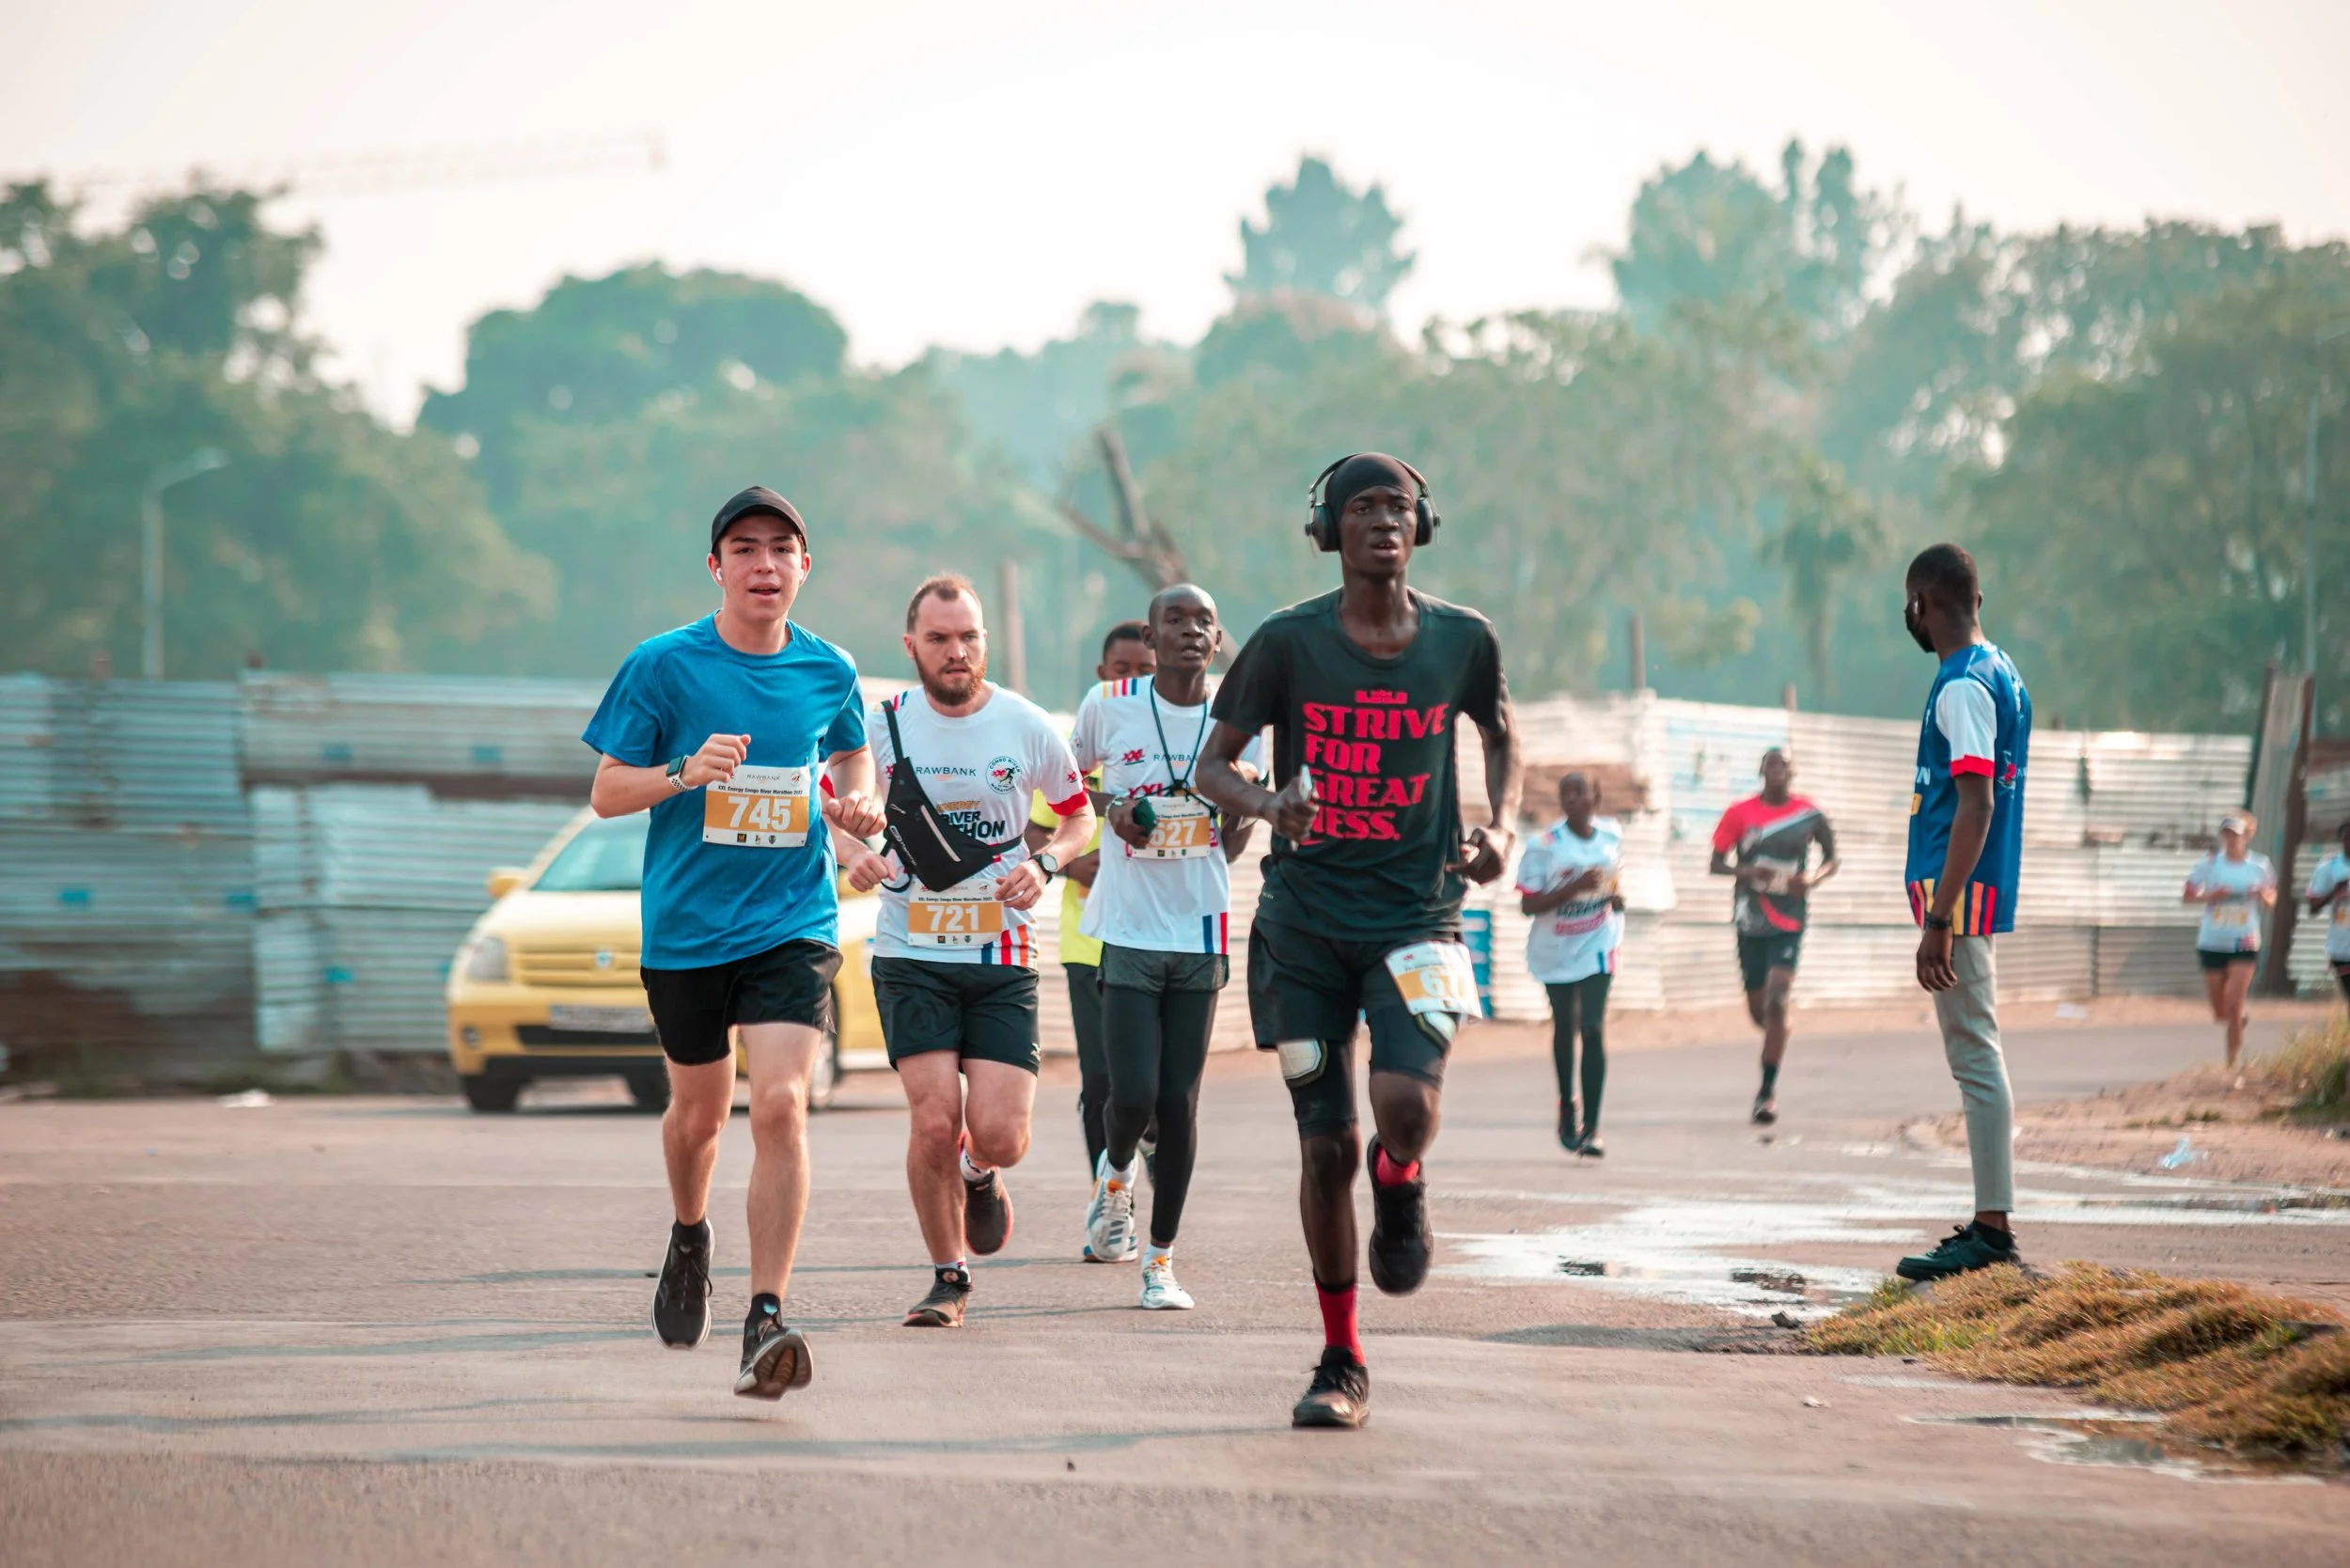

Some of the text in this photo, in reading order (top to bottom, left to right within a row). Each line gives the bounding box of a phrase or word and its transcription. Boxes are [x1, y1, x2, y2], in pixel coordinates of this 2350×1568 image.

[1302, 701, 1449, 741] STRIVE
[1305, 732, 1382, 775] FOR
[916, 766, 977, 776] RAWBANK
[728, 795, 791, 832] 745
[1150, 820, 1198, 847] 627
[926, 904, 979, 932] 721
